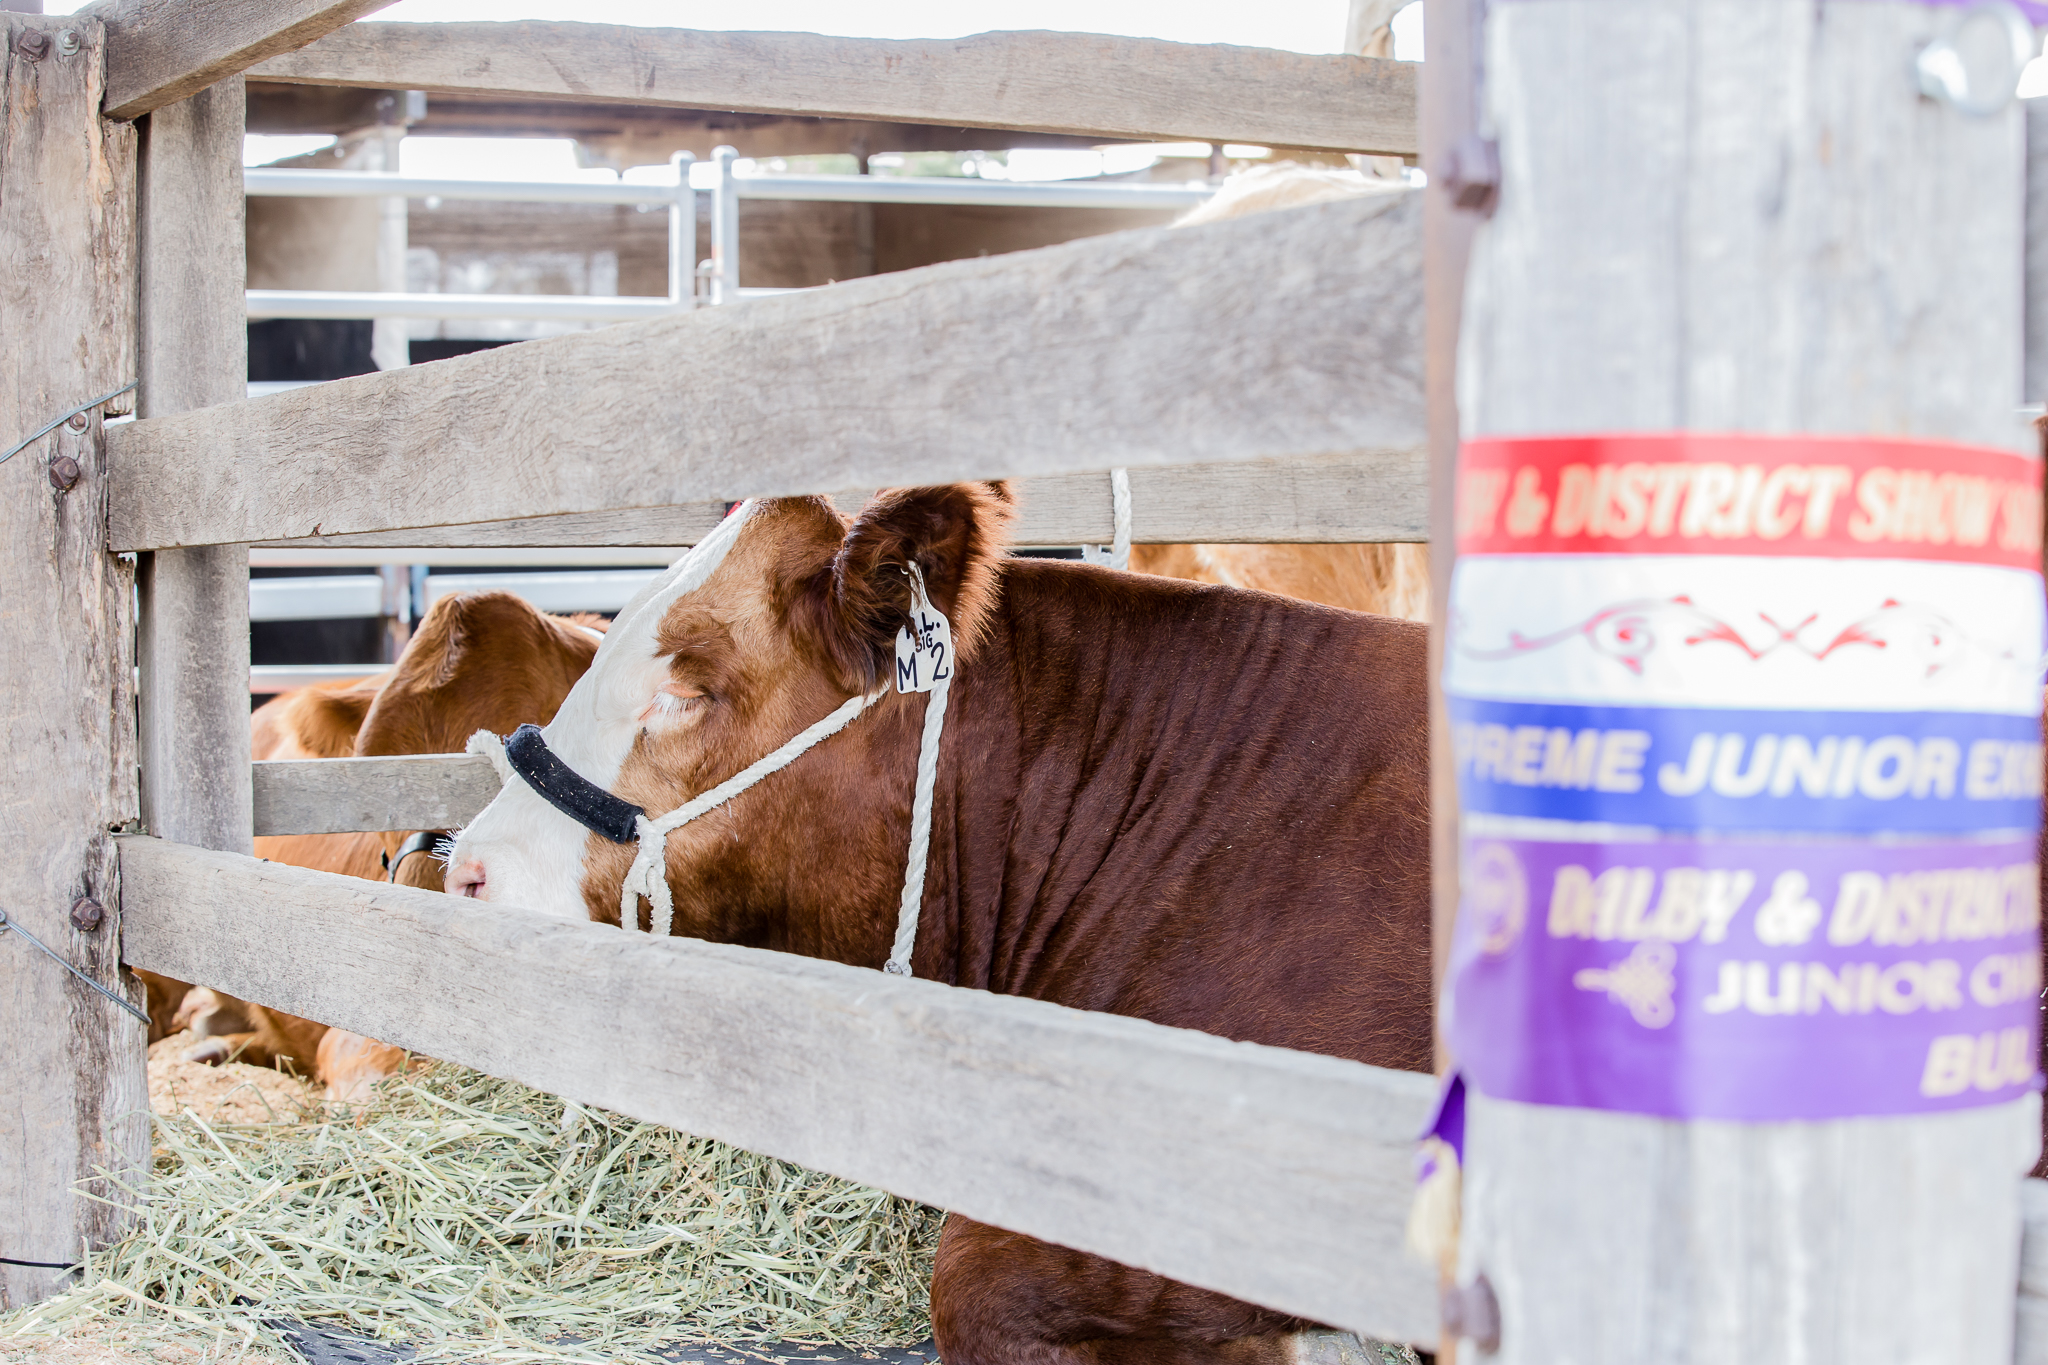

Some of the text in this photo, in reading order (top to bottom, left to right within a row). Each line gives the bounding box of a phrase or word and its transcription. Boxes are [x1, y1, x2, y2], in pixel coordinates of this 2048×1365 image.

[1552, 462, 1853, 541] DISTRICT
[1849, 467, 2004, 547] SHOW
[1657, 733, 1961, 800] JUNIOR
[1547, 864, 1757, 945] DALBY
[1754, 868, 1823, 947] &
[1702, 958, 1963, 1016] JUNIOR
